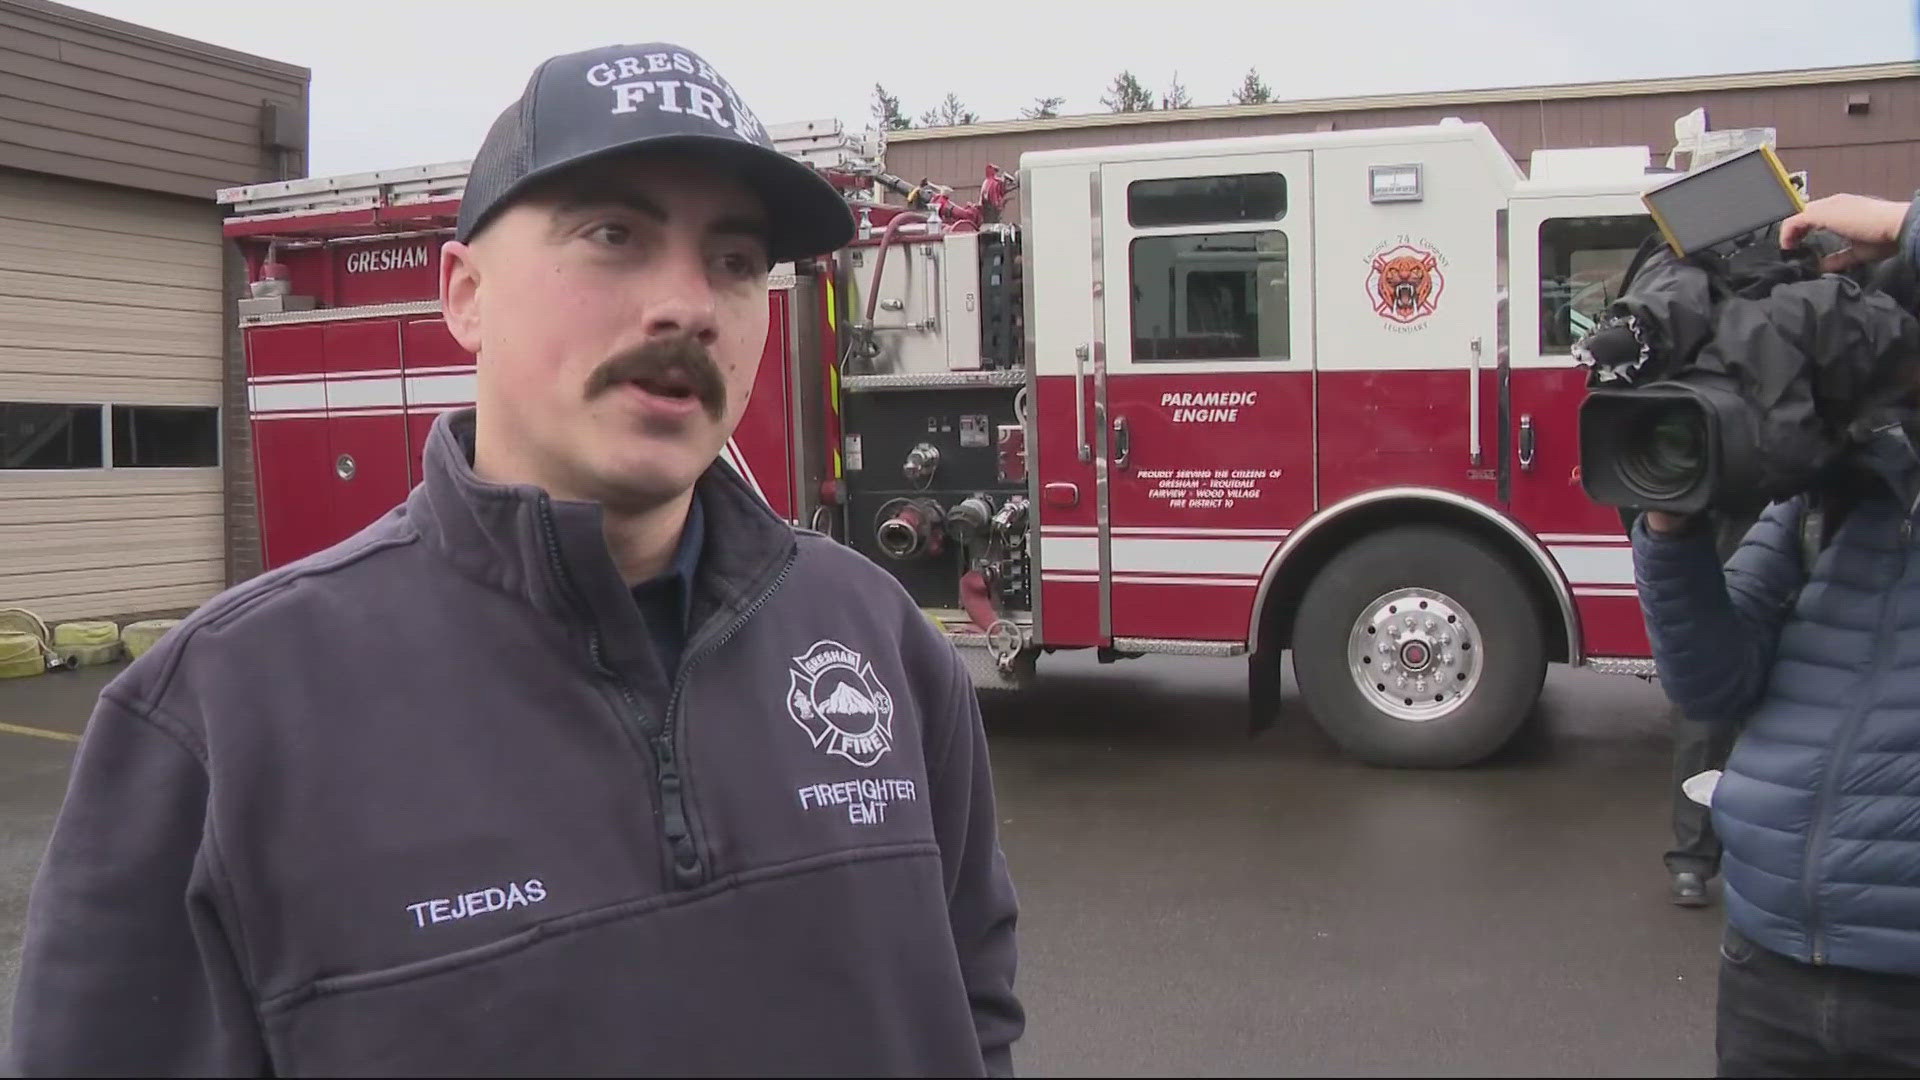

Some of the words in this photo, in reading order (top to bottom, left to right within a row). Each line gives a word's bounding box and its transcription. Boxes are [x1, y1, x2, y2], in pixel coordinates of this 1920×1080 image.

[611, 80, 760, 146] FIRE
[347, 246, 428, 273] GRESHAM
[1161, 391, 1257, 406] PARAMEDIC
[1173, 408, 1238, 422] ENGINE
[1137, 470, 1174, 479] PROUDLY
[1176, 470, 1211, 479] SERVING
[1214, 470, 1229, 479] THE
[1231, 470, 1266, 479] CITIZENS
[1269, 470, 1282, 478] OF
[1159, 480, 1199, 488] GRESHAM
[1210, 480, 1255, 488] TROUTDALE
[1149, 489, 1186, 498] FAIRVIEW
[1196, 489, 1224, 498] WOOD
[1227, 489, 1260, 498] VILLAGE
[1170, 499, 1186, 508] FIRE
[1189, 499, 1222, 508] DISTRICT
[1225, 499, 1234, 508] 10
[805, 650, 857, 673] GRESHAM
[842, 733, 882, 754] FIRE
[799, 779, 916, 810] FIREFIGHTER
[849, 801, 887, 824] EMT
[406, 879, 547, 928] TEJEDAS
